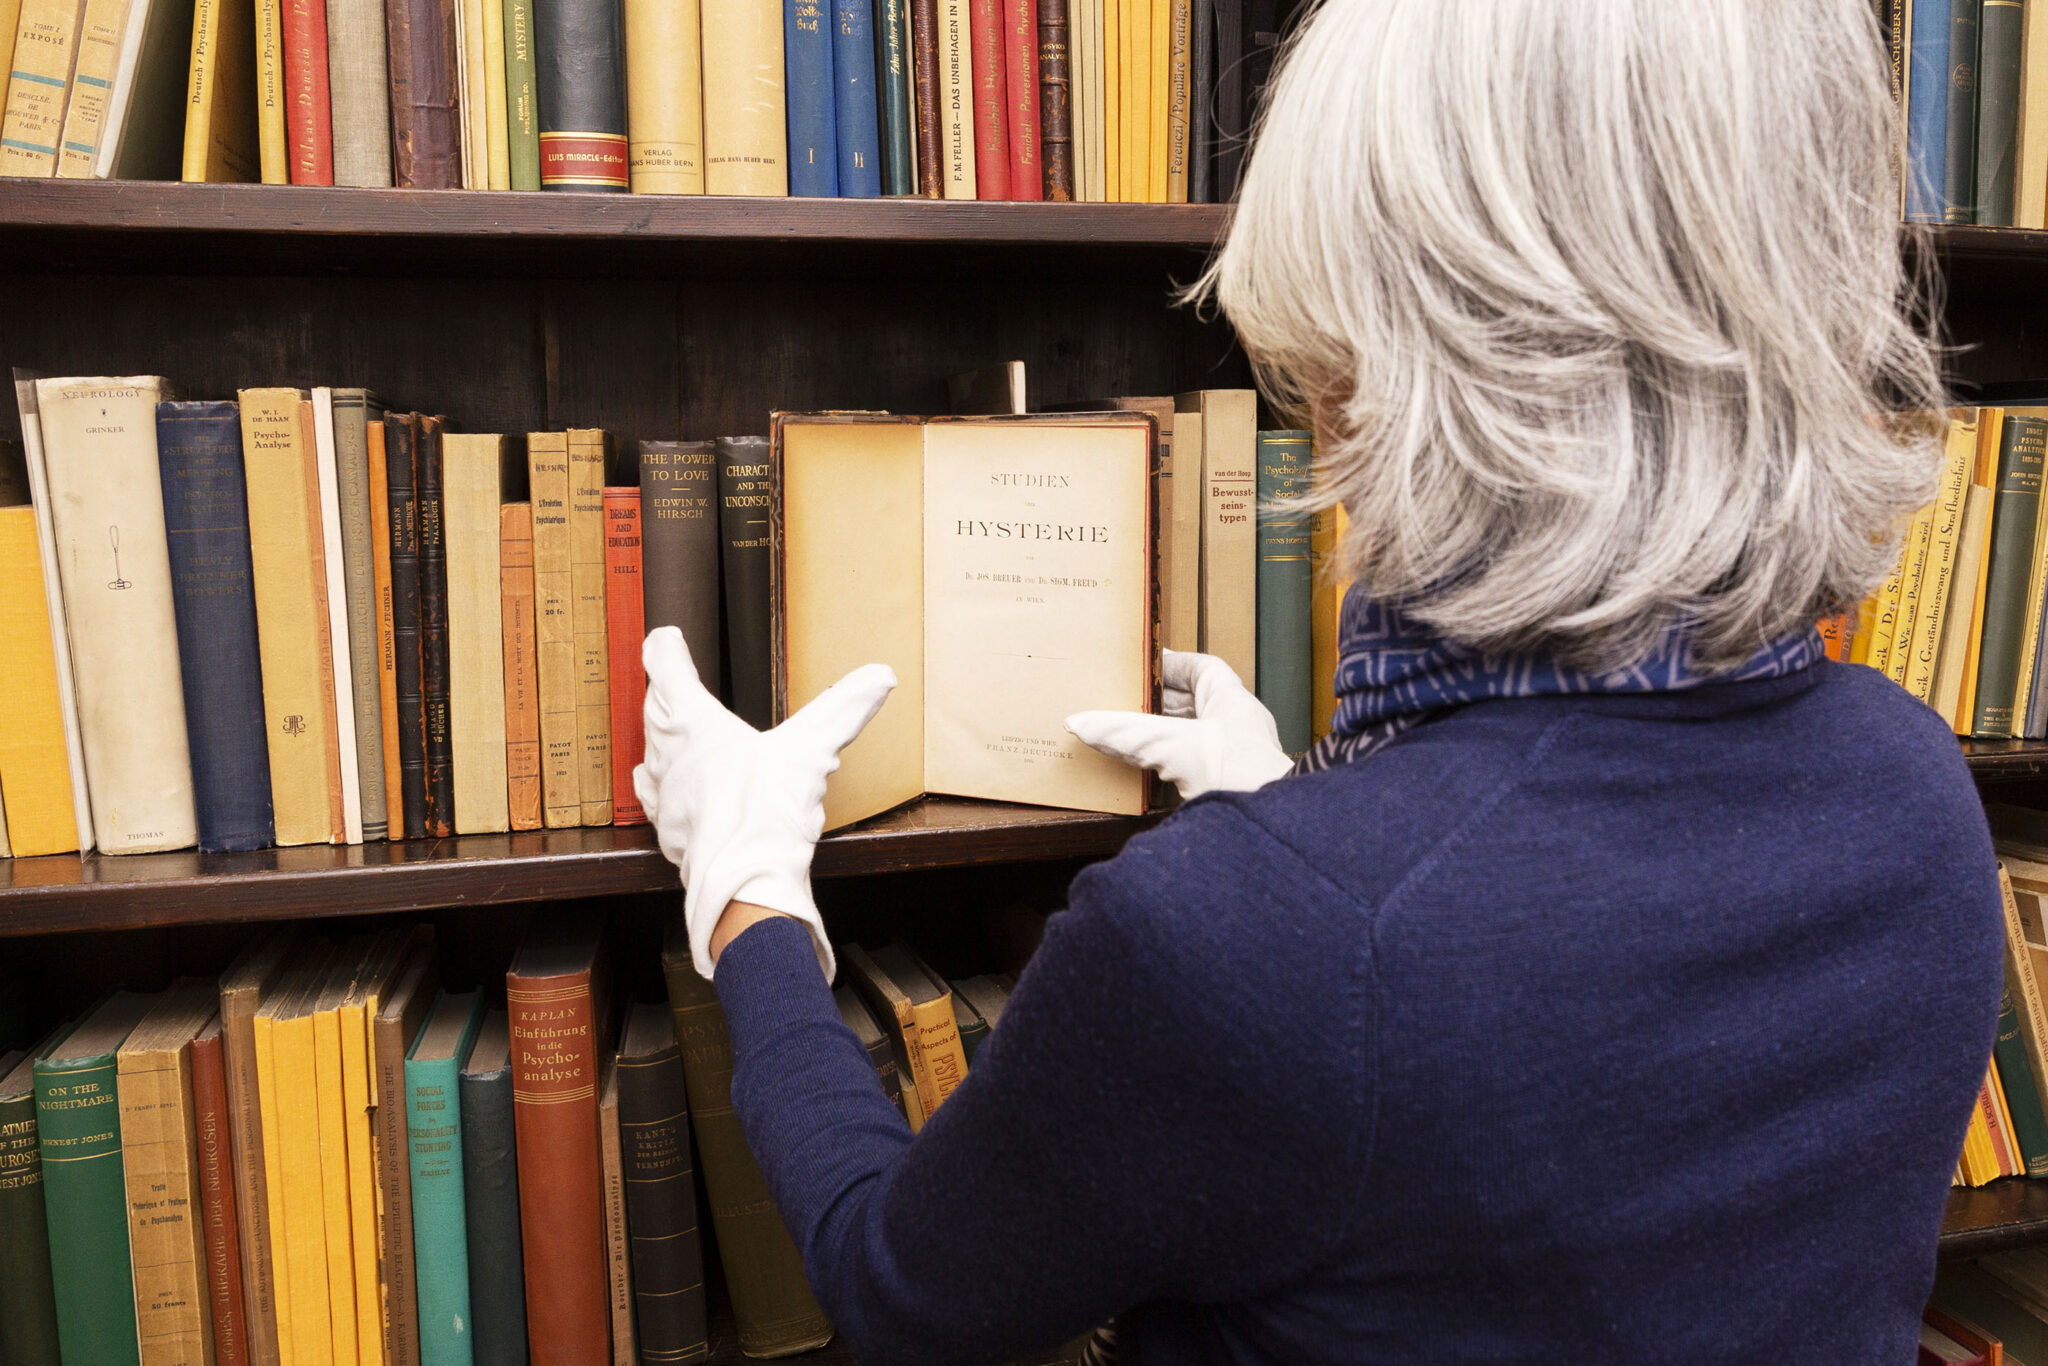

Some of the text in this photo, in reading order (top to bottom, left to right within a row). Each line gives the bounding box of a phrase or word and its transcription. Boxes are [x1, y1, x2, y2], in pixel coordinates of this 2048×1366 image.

[23, 31, 64, 46] EXPOSÉ
[514, 4, 527, 61] MYSTERY
[984, 27, 1000, 89] Hysterien
[950, 6, 962, 160] FELLER DAS UNBEHAGEN IN
[1019, 42, 1032, 112] Perversionen,
[192, 67, 203, 104] Deutsch
[266, 69, 274, 108] Deutsch
[1171, 3, 1191, 174] Ferenczi Populäre Vorträge
[301, 118, 316, 174] Helene
[548, 153, 564, 162] LUIS
[645, 159, 694, 168] HUBER BERN
[854, 151, 865, 168] II
[62, 389, 142, 400] NEUROLOGY
[86, 425, 125, 434] GRINKER
[253, 431, 291, 440] Psycho-
[254, 440, 292, 450] Analyse
[641, 454, 716, 465] THE POWER
[1280, 453, 1297, 462] The
[650, 470, 709, 480] TO LOVE
[991, 472, 1072, 488] STUDIEN
[1229, 469, 1237, 477] der
[346, 424, 361, 543] PSYCHOANALYSE
[737, 482, 754, 491] AND
[1283, 478, 1294, 487] of
[1212, 487, 1254, 497] Bewusst-
[654, 498, 708, 507] EDWIN W.
[1221, 501, 1247, 510] seins-
[610, 508, 636, 519] DREAMS
[657, 510, 703, 519] HIRSCH
[1219, 513, 1247, 524] typen
[394, 507, 402, 547] HERMANN
[616, 524, 631, 532] AND
[957, 520, 1109, 543] HYSTERIE
[608, 537, 640, 547] EDUCATION
[355, 553, 366, 577] DER
[1919, 455, 1966, 662] Geständniszwang und Strafbedürfnis
[613, 566, 637, 574] HILL
[993, 574, 1021, 583] BREUER
[1073, 578, 1098, 588] FREUD
[1898, 627, 1912, 652] Wie
[1921, 521, 1929, 544] wird
[1882, 600, 1896, 624] Der
[384, 630, 392, 670] HERMANN
[1001, 735, 1039, 745] LEIPZIG UND
[986, 744, 1018, 754] FRANZ
[127, 831, 164, 841] THOMAS
[2003, 879, 2033, 985] DIE PSYCHOANALYSE
[521, 1007, 576, 1021] KAPLAN
[514, 1025, 587, 1038] Einführung
[920, 1019, 950, 1035] Practical
[548, 1041, 562, 1050] die
[921, 1031, 957, 1050] Aspects of
[524, 1068, 581, 1083] analyse
[48, 1083, 100, 1096] ON THE
[416, 1086, 444, 1096] SOCIAL
[40, 1094, 114, 1110] NIGHTMARE
[417, 1100, 446, 1111] FORCES
[0, 1119, 36, 1137] ATME
[409, 1126, 457, 1138] PERSONALITY
[11, 1137, 35, 1149] THE
[43, 1132, 114, 1146] ERNEST JONES
[204, 1111, 220, 1192] NEUROSEN
[415, 1142, 451, 1153] STUNTING
[385, 1065, 403, 1246] THE BIO-ANALYSIS OF THE EPILEPTIC
[211, 1200, 224, 1227] DER
[612, 1175, 622, 1241] Psychoanalyse
[216, 1236, 231, 1305] THERAPIE
[259, 1296, 268, 1313] THE
